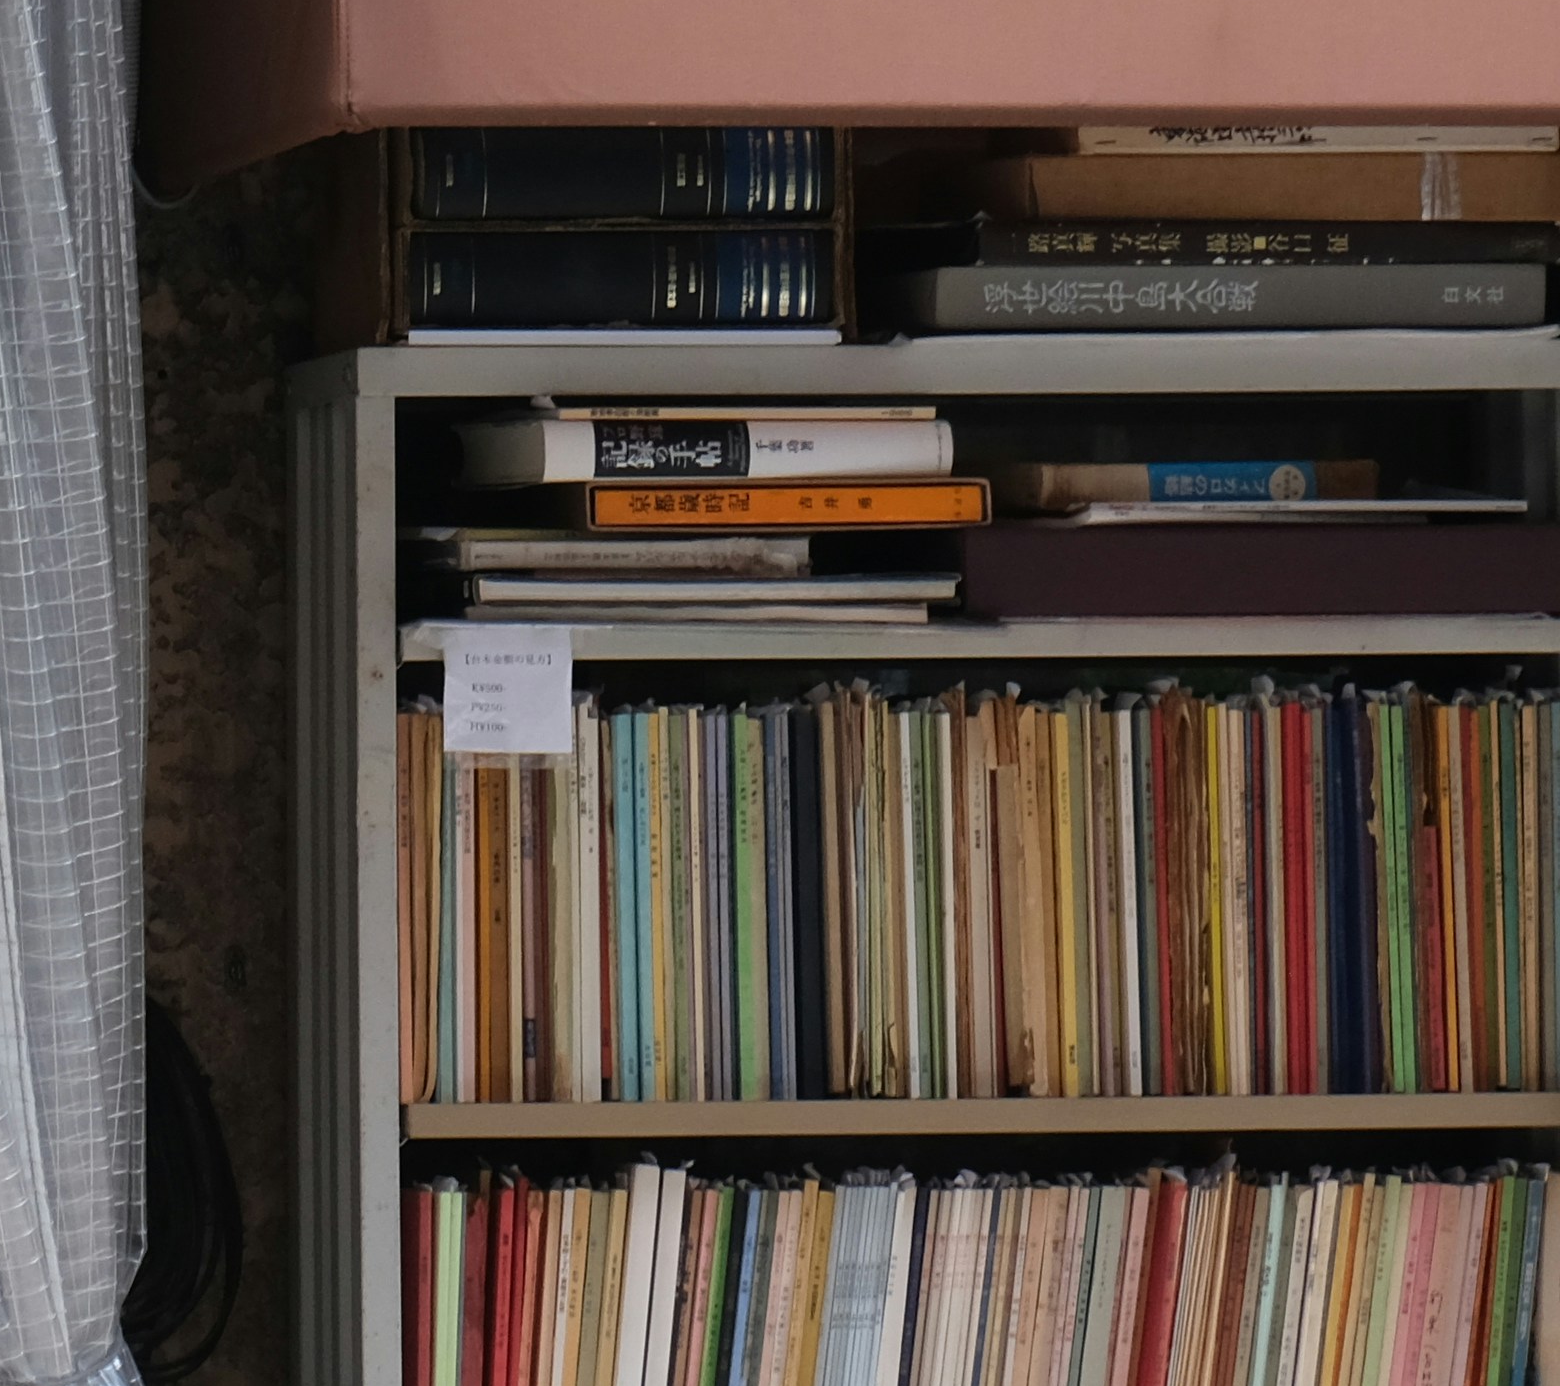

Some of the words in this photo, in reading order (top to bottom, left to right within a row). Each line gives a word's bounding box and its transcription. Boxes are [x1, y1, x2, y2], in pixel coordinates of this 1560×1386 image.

[984, 279, 1260, 314] 浮世絵川中島大合戦
[600, 441, 722, 470] 記録の手帖
